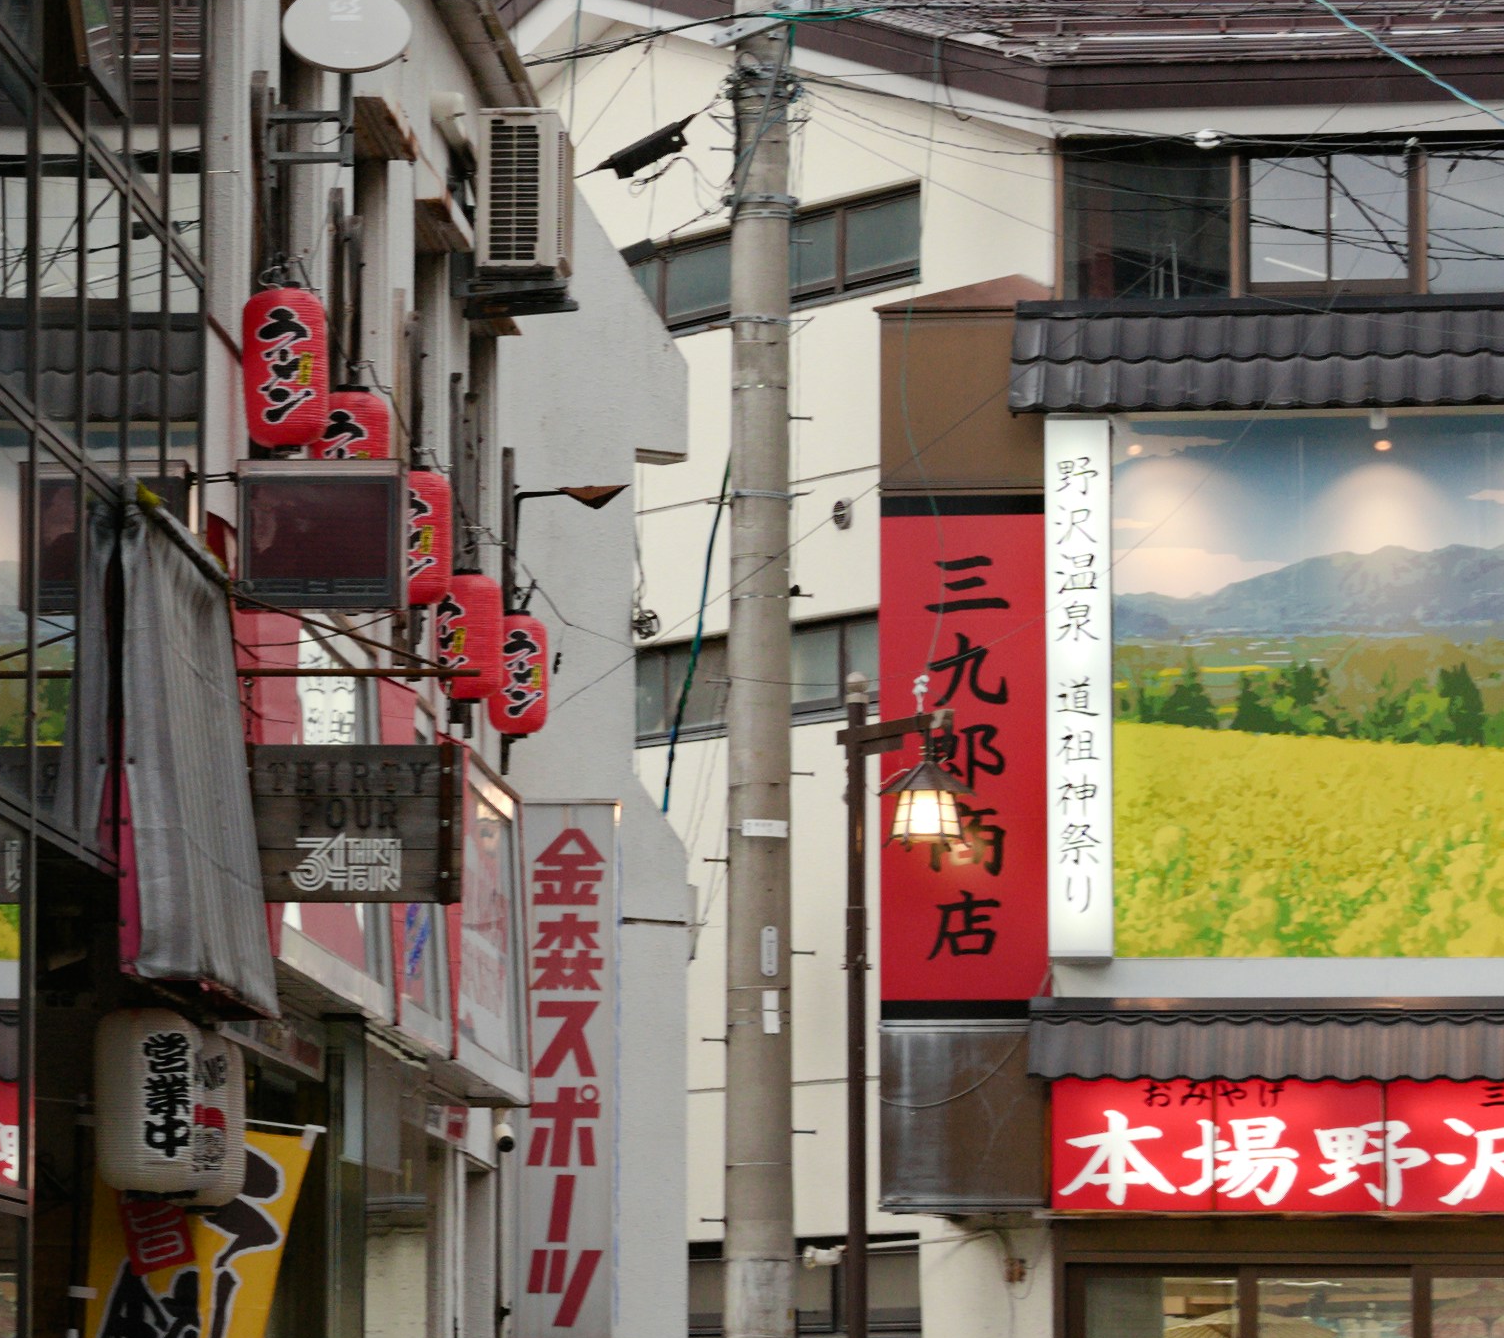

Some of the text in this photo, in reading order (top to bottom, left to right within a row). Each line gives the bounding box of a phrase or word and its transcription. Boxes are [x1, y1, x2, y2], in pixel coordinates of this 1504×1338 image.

[256, 306, 316, 425] ラーメン
[502, 628, 543, 718] ラーメン
[1054, 455, 1103, 915] 野沢温泉 道祖神祭り
[267, 760, 431, 793] THIRTY
[298, 798, 398, 830] FOUR
[925, 554, 1010, 962] 三九郎商店
[143, 1032, 190, 1158] 営業中
[526, 827, 606, 1328] 金森スポーツ
